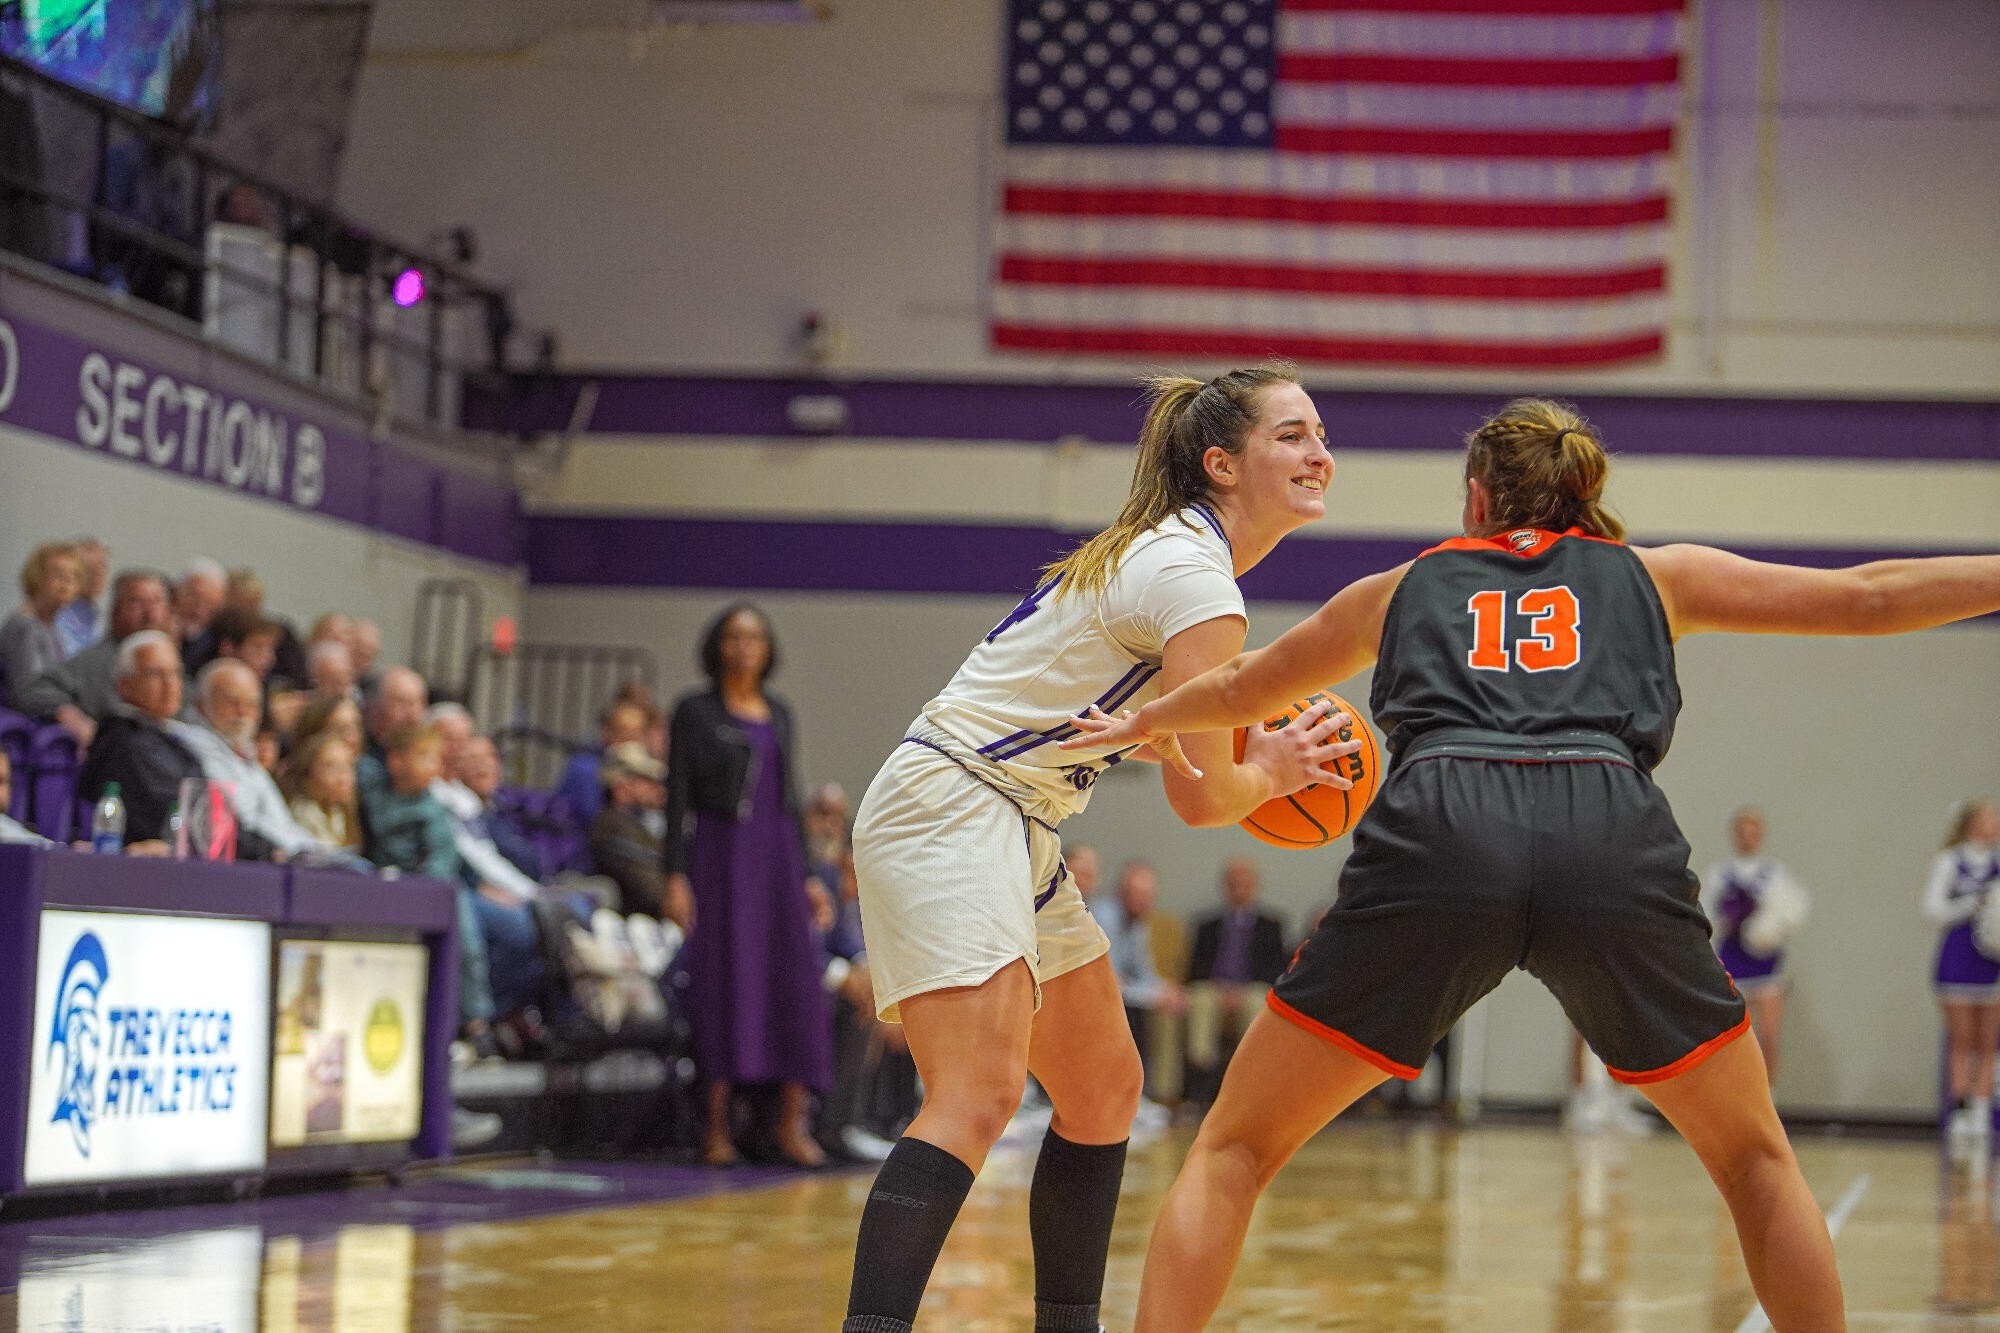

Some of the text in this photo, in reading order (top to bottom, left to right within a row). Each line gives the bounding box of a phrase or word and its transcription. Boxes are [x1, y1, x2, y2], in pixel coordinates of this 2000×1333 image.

[75, 351, 288, 497] SECTION
[293, 422, 326, 507] B
[1467, 584, 1581, 673] 13
[108, 1008, 231, 1056] TREVECCA
[102, 1066, 237, 1116] ATHLETICS
